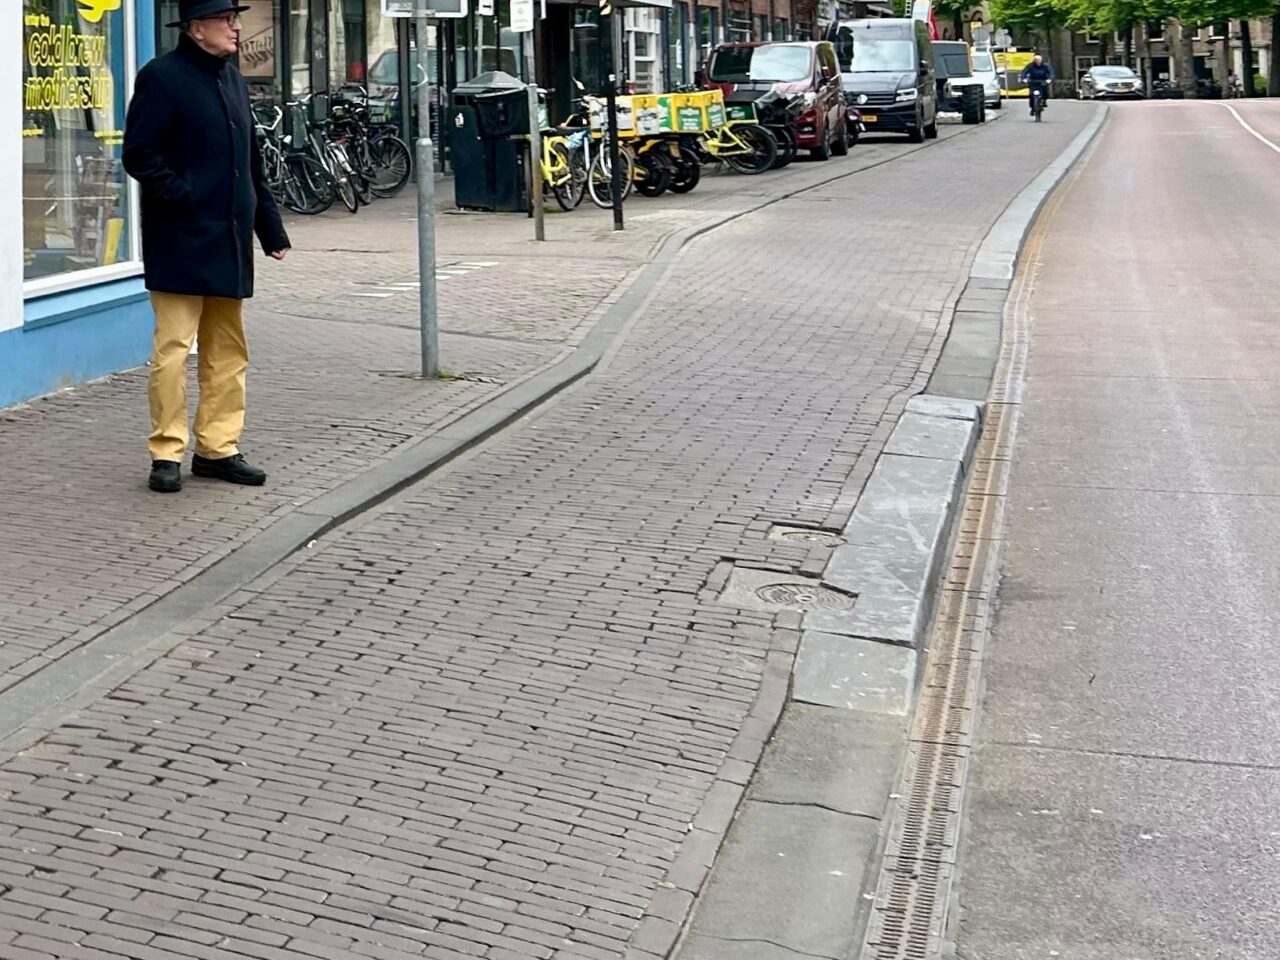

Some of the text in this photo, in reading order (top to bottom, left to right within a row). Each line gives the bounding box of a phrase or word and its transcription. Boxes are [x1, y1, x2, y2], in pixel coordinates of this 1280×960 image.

[28, 24, 105, 68] cold brew
[24, 67, 113, 118] mothership
